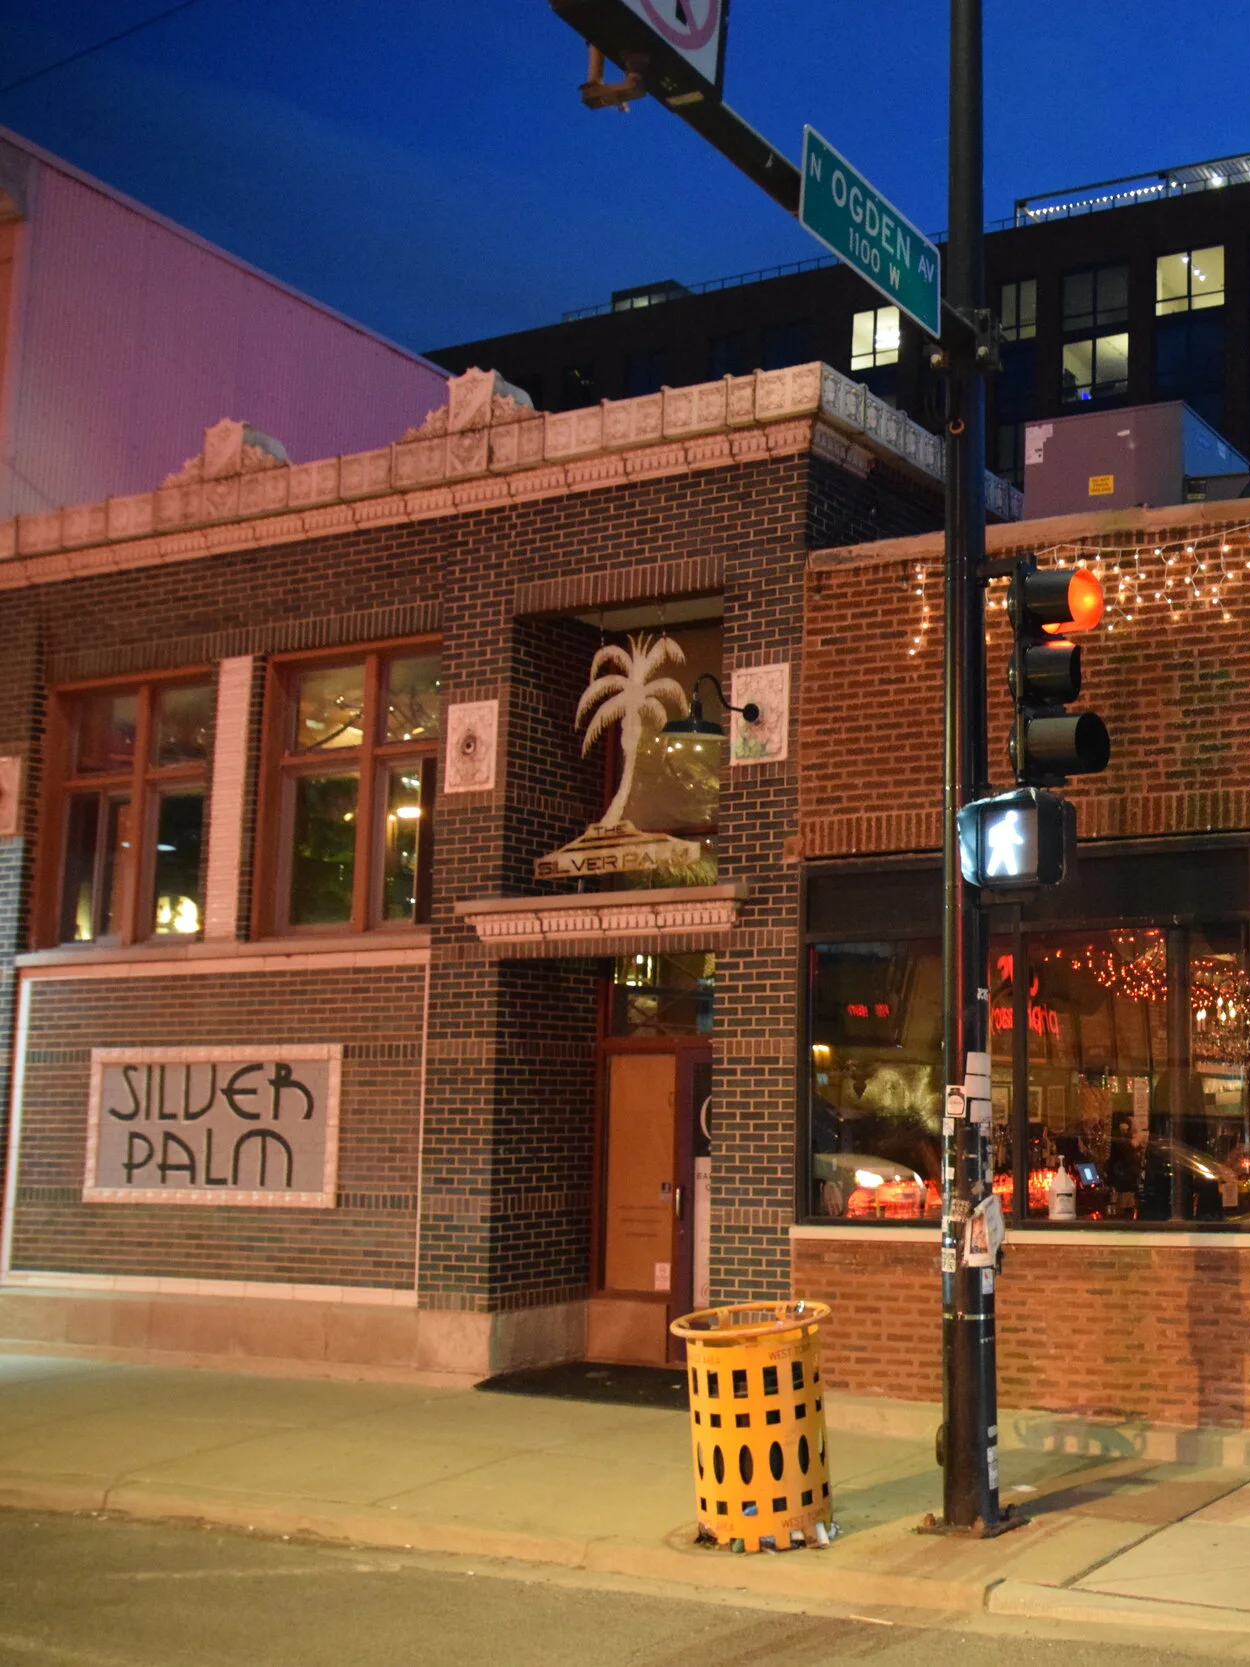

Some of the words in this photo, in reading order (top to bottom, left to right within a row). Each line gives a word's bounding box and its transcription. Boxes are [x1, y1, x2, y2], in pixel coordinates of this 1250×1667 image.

[810, 151, 821, 182] N
[832, 170, 911, 269] OGDEN
[918, 254, 935, 283] AV
[849, 227, 881, 273] 1100
[889, 262, 900, 291] W
[593, 824, 627, 836] THE
[537, 855, 618, 876] SILVER
[107, 1062, 315, 1122] SILVER
[122, 1127, 293, 1188] PALM
[767, 1347, 792, 1361] WEST
